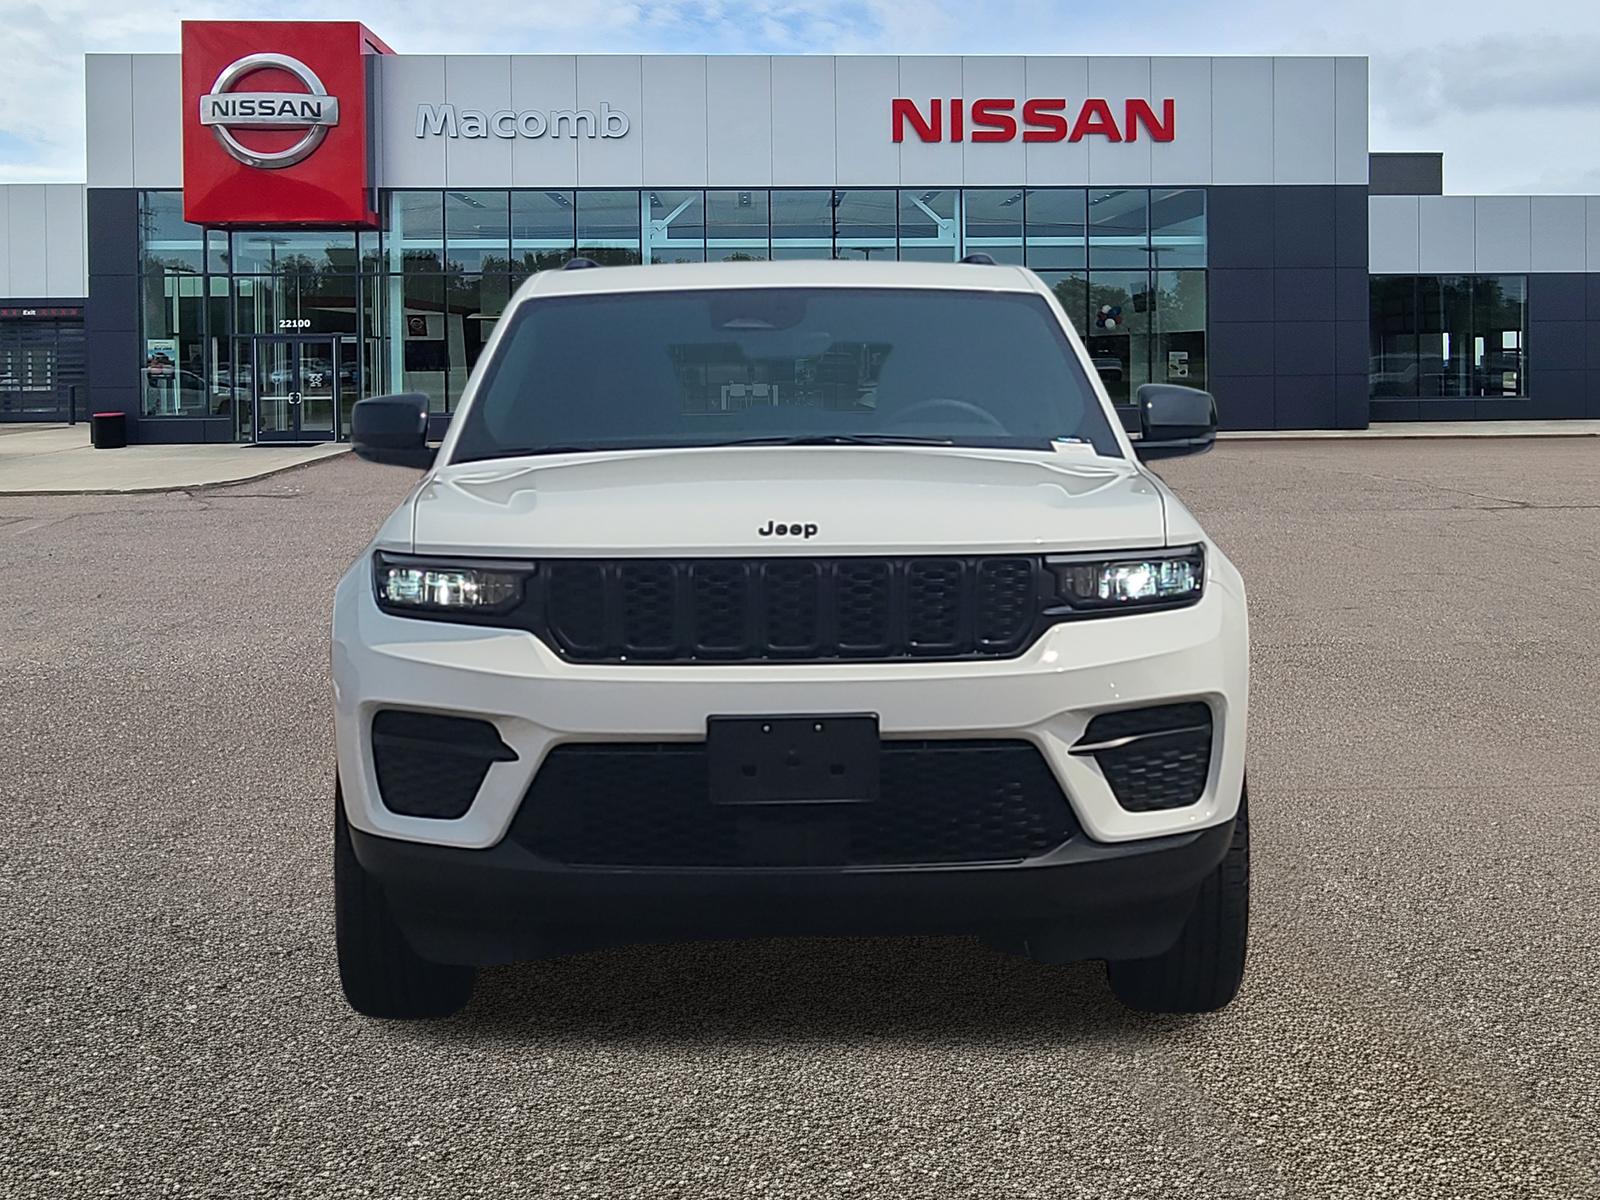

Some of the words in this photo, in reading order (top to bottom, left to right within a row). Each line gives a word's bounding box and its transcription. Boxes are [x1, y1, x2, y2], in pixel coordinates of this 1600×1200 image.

[212, 100, 322, 117] NISSAN
[415, 102, 630, 138] Macomb
[891, 98, 1176, 143] NISSAN
[279, 319, 311, 328] 22100
[758, 520, 818, 539] Jeep
